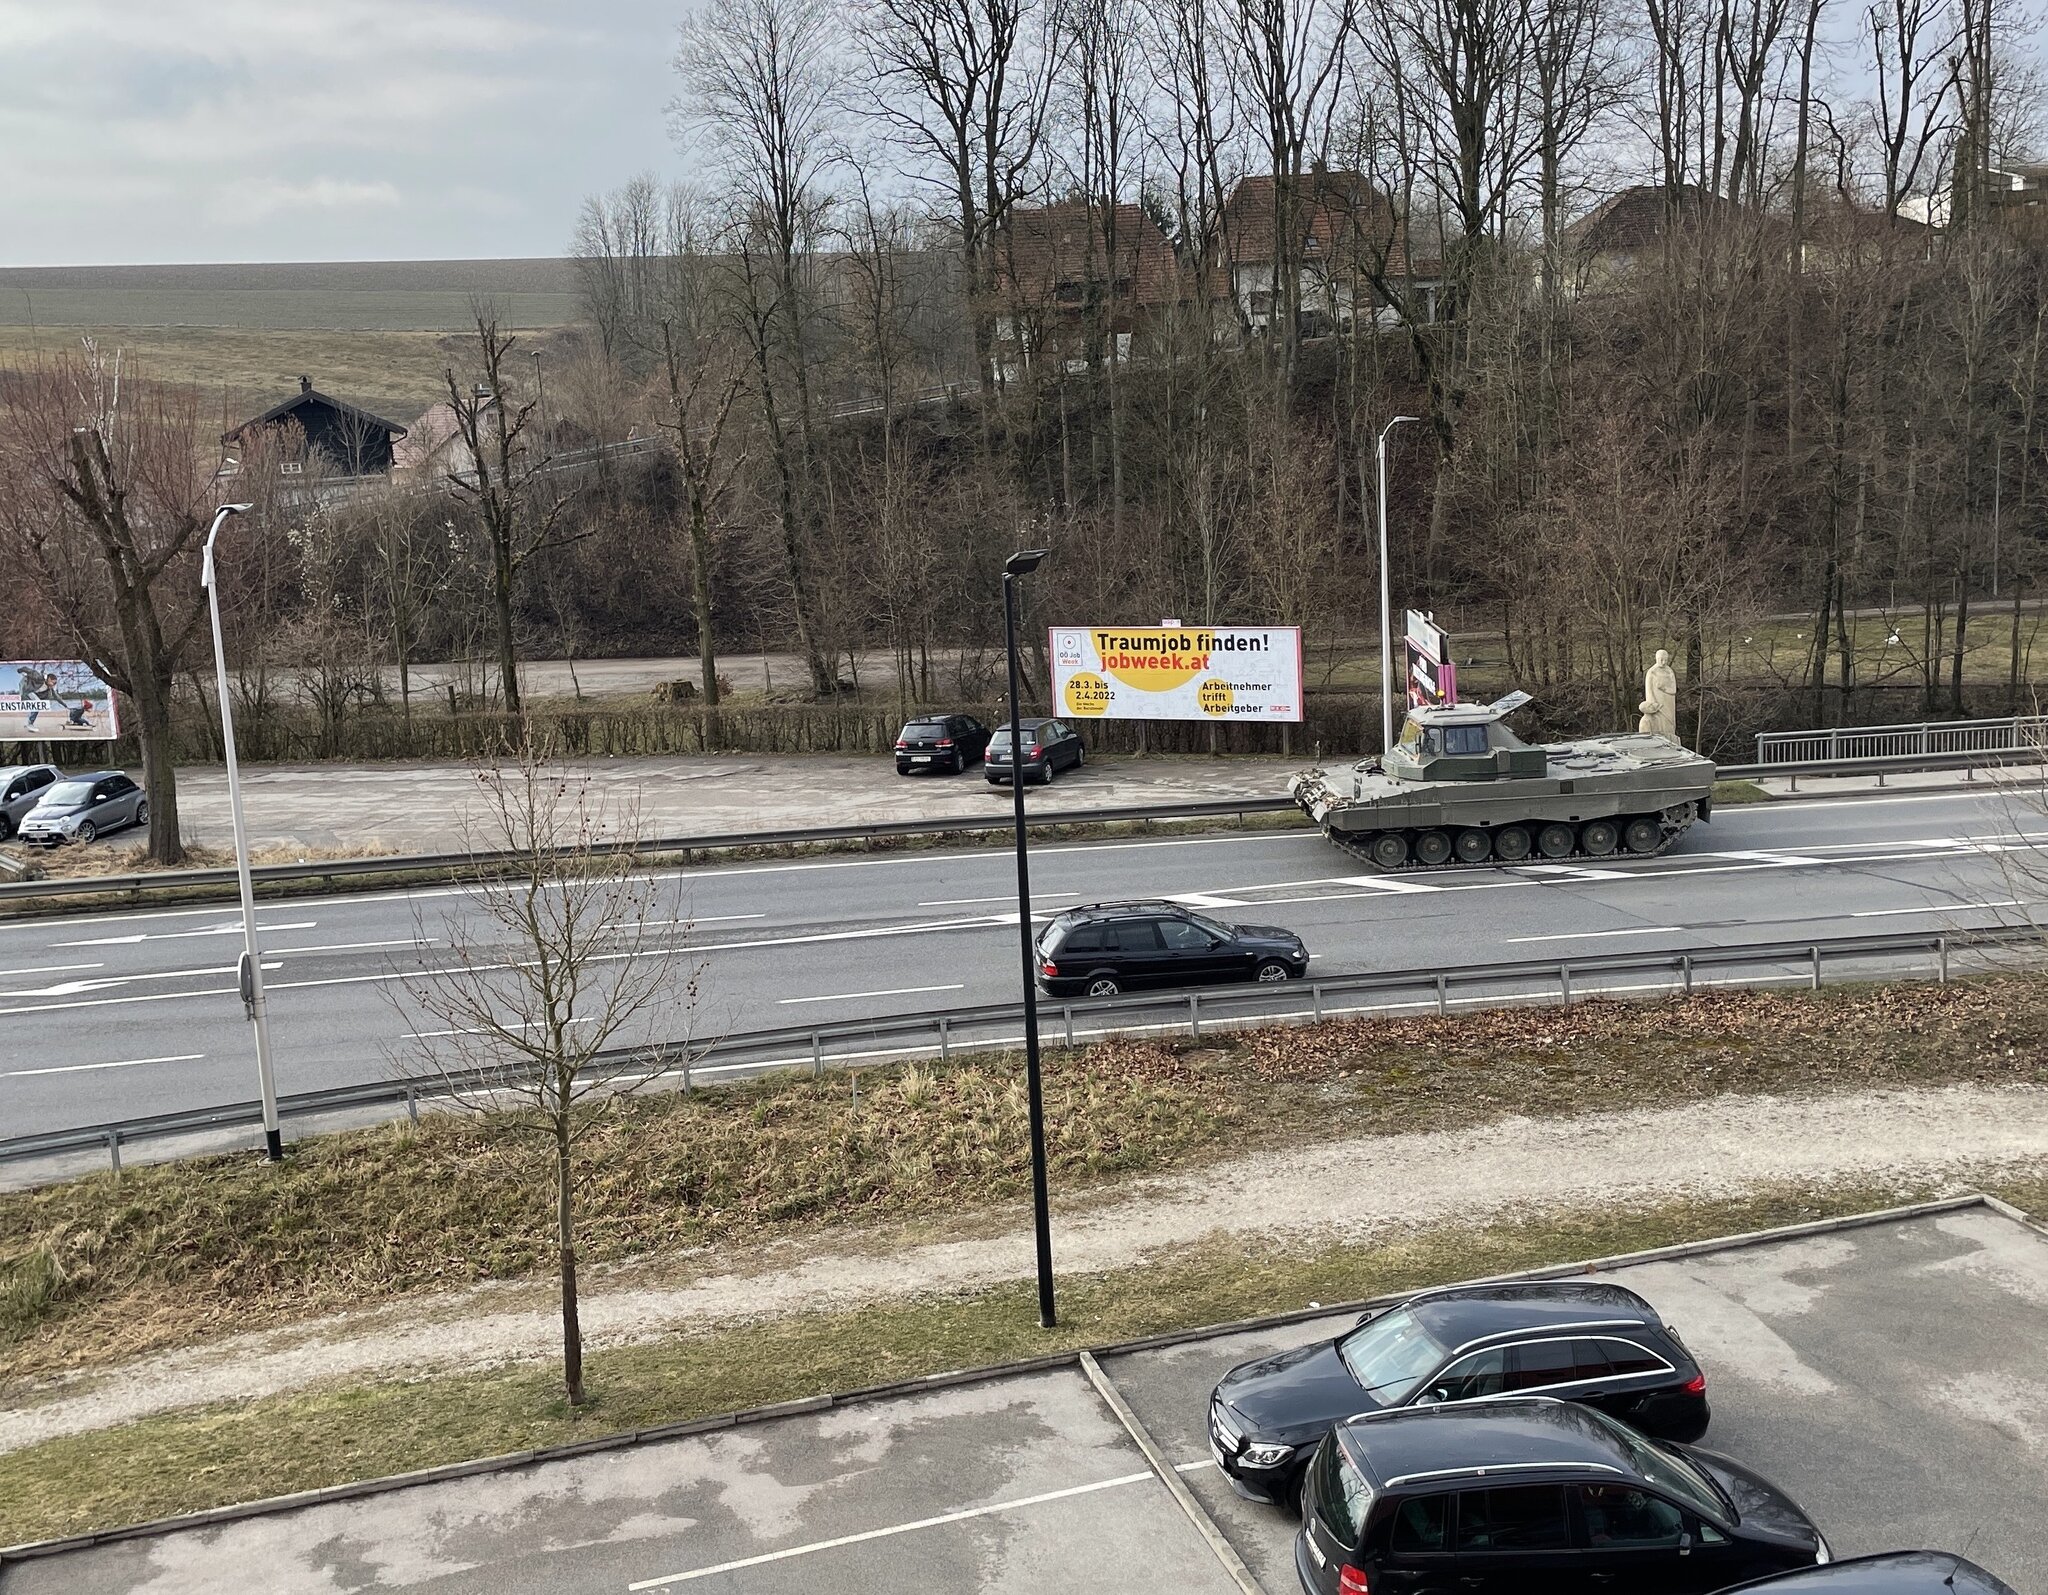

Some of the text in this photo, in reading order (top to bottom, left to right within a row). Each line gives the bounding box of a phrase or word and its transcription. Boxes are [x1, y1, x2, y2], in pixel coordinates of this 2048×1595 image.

[1097, 633, 1269, 654] Traumjob finden!
[1100, 652, 1210, 672] jobweek.at
[1069, 680, 1109, 689] 28.3. bis
[1202, 682, 1273, 691] Arbeitnehmer
[1075, 691, 1116, 700] 2.4.2022
[1202, 692, 1227, 702] trifft
[1203, 704, 1263, 714] Arbeitgeber
